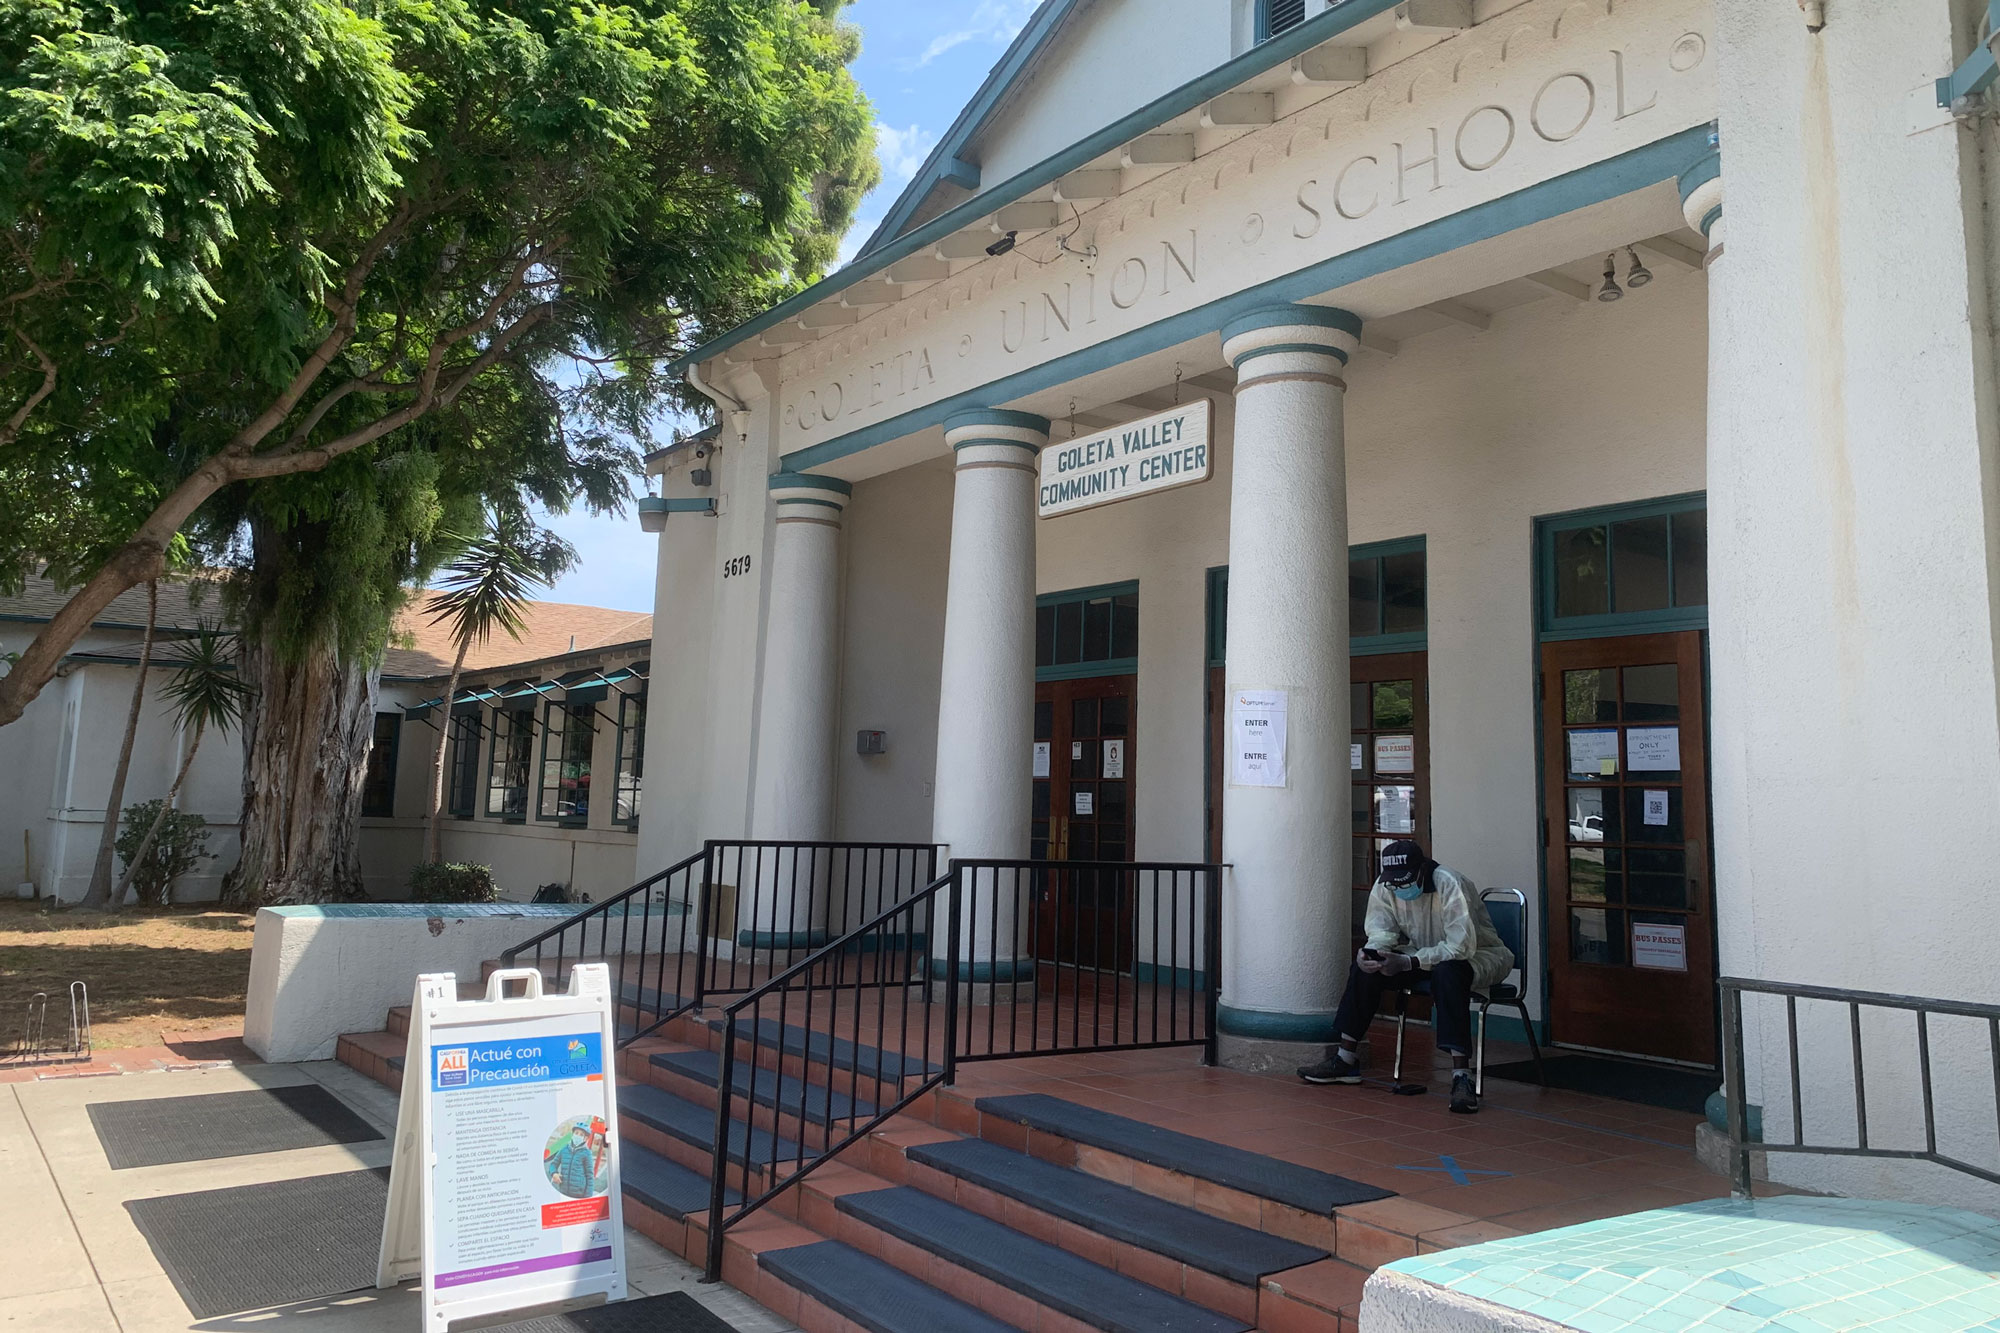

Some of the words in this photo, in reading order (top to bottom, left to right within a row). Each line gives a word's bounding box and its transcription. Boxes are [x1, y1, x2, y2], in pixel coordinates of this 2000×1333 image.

[798, 347, 936, 431] GOLETA
[1000, 228, 1197, 354] UNION
[1292, 48, 1658, 240] SCHOOL
[1057, 437, 1115, 473] GOLETA
[1122, 416, 1185, 455] VALLEY
[1040, 463, 1130, 507] COMMUNITY
[1139, 444, 1206, 482] CENTER
[723, 554, 751, 579] 5679
[1244, 719, 1268, 727] ENTER
[1639, 742, 1659, 750] ONLY
[1243, 752, 1267, 760] ENTRE
[1635, 934, 1650, 943] BUS
[1651, 935, 1682, 945] PASSES
[440, 1055, 467, 1071] ALL
[470, 1046, 513, 1064] Actué
[516, 1047, 542, 1059] con
[471, 1062, 550, 1082] Precaución
